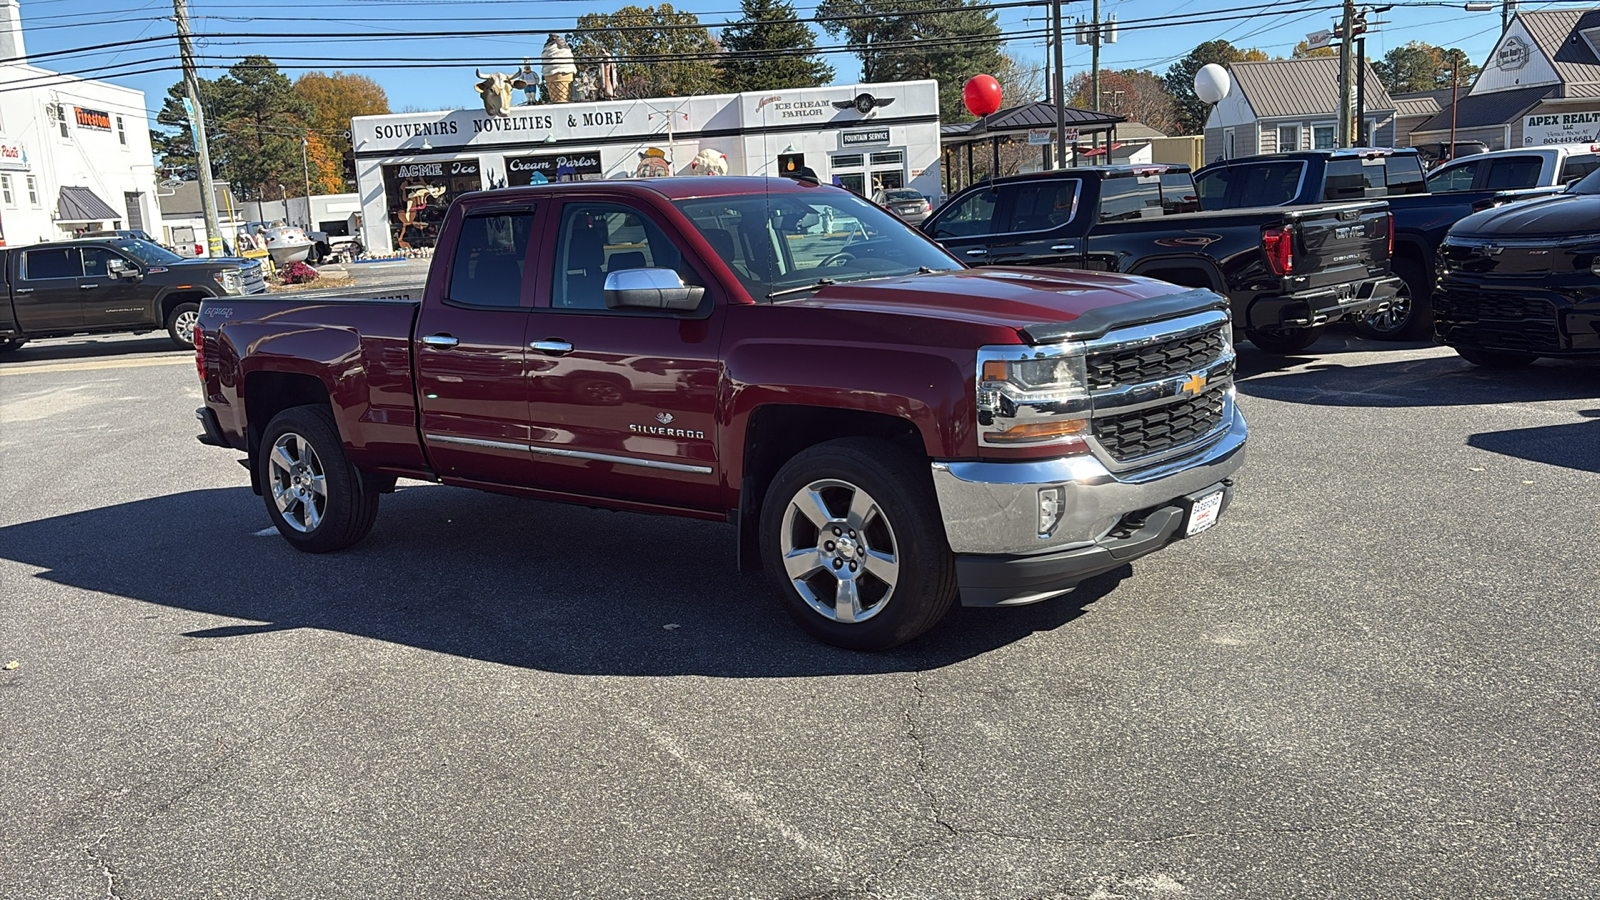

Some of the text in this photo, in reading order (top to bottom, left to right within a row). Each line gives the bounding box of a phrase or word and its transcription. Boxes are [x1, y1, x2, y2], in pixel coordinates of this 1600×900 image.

[774, 100, 831, 111] ICE CREAM
[74, 107, 111, 128] Firestone
[782, 109, 823, 118] PARLOR
[375, 111, 624, 139] SOUVENIRS NOVELTIES & MORE
[1528, 115, 1559, 127] APEX
[844, 132, 888, 142] FOUNTAIN SERVICE
[1, 144, 19, 159] Paints
[398, 156, 598, 178] ACME Ice Cream Parlor
[1335, 225, 1365, 239] GMC
[629, 424, 704, 439] SILVERADO
[1197, 510, 1210, 520] GMC
